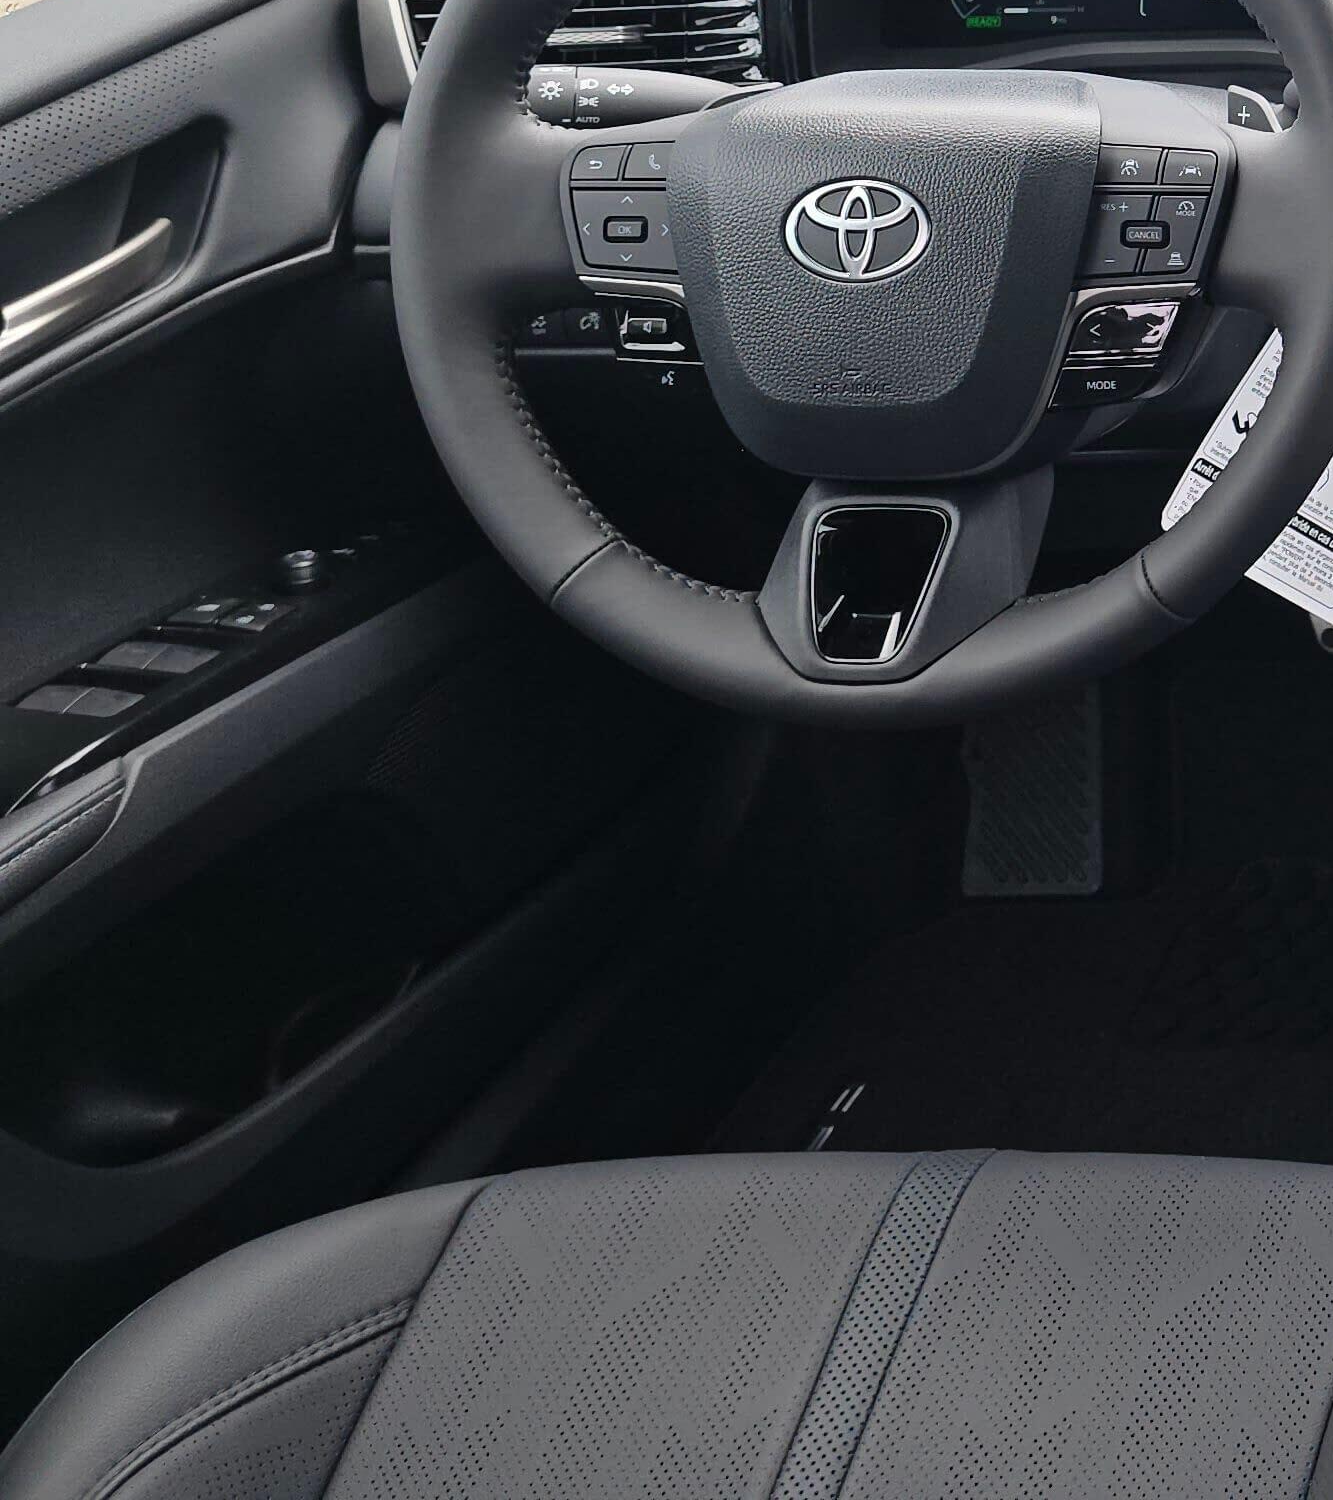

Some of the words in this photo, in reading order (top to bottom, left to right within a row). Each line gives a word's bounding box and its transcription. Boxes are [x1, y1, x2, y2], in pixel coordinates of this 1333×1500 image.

[617, 225, 632, 234] OK
[1128, 230, 1160, 240] CANCEL
[812, 383, 838, 395] SRS
[1086, 380, 1117, 390] MODE
